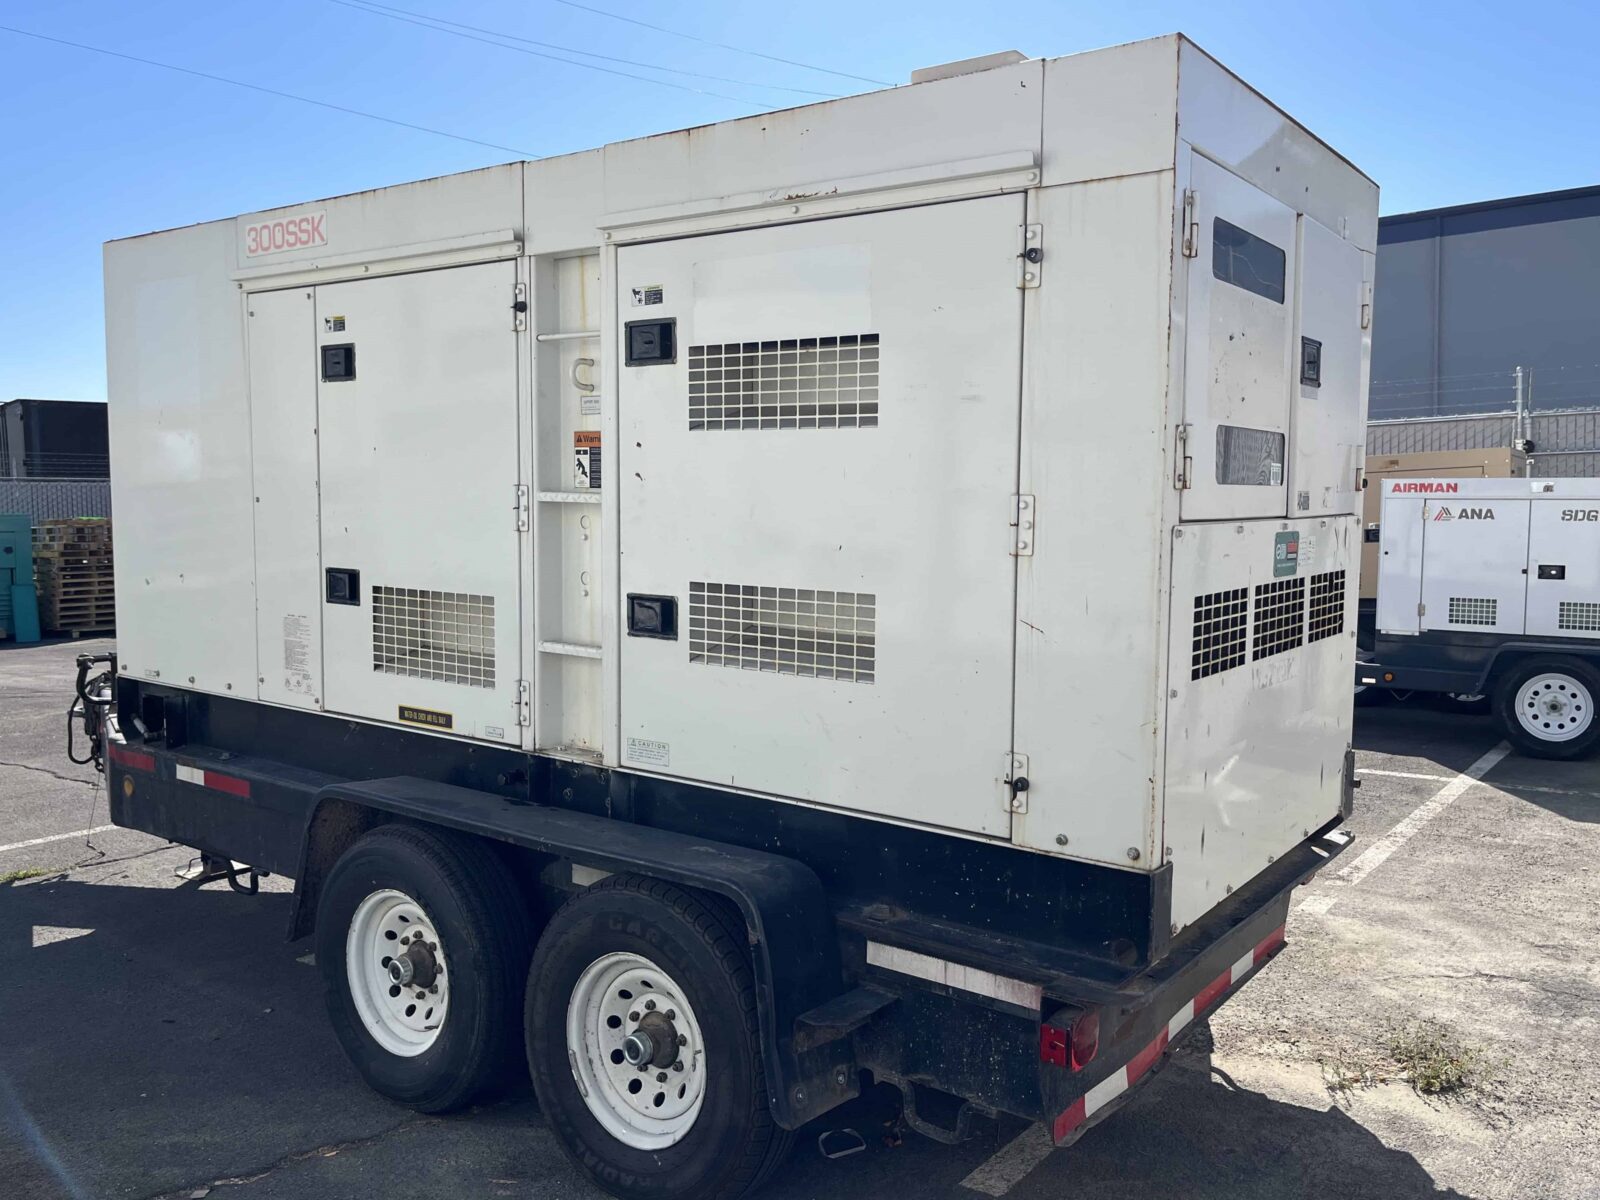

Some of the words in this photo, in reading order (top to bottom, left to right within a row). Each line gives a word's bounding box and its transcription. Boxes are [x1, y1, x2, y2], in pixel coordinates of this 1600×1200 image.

[247, 214, 326, 254] 300SSK
[583, 434, 601, 443] Warni
[1392, 482, 1458, 493] AIRMAN
[1458, 508, 1495, 520] ANA
[1561, 509, 1599, 522] SDG
[638, 740, 666, 750] CAUTION
